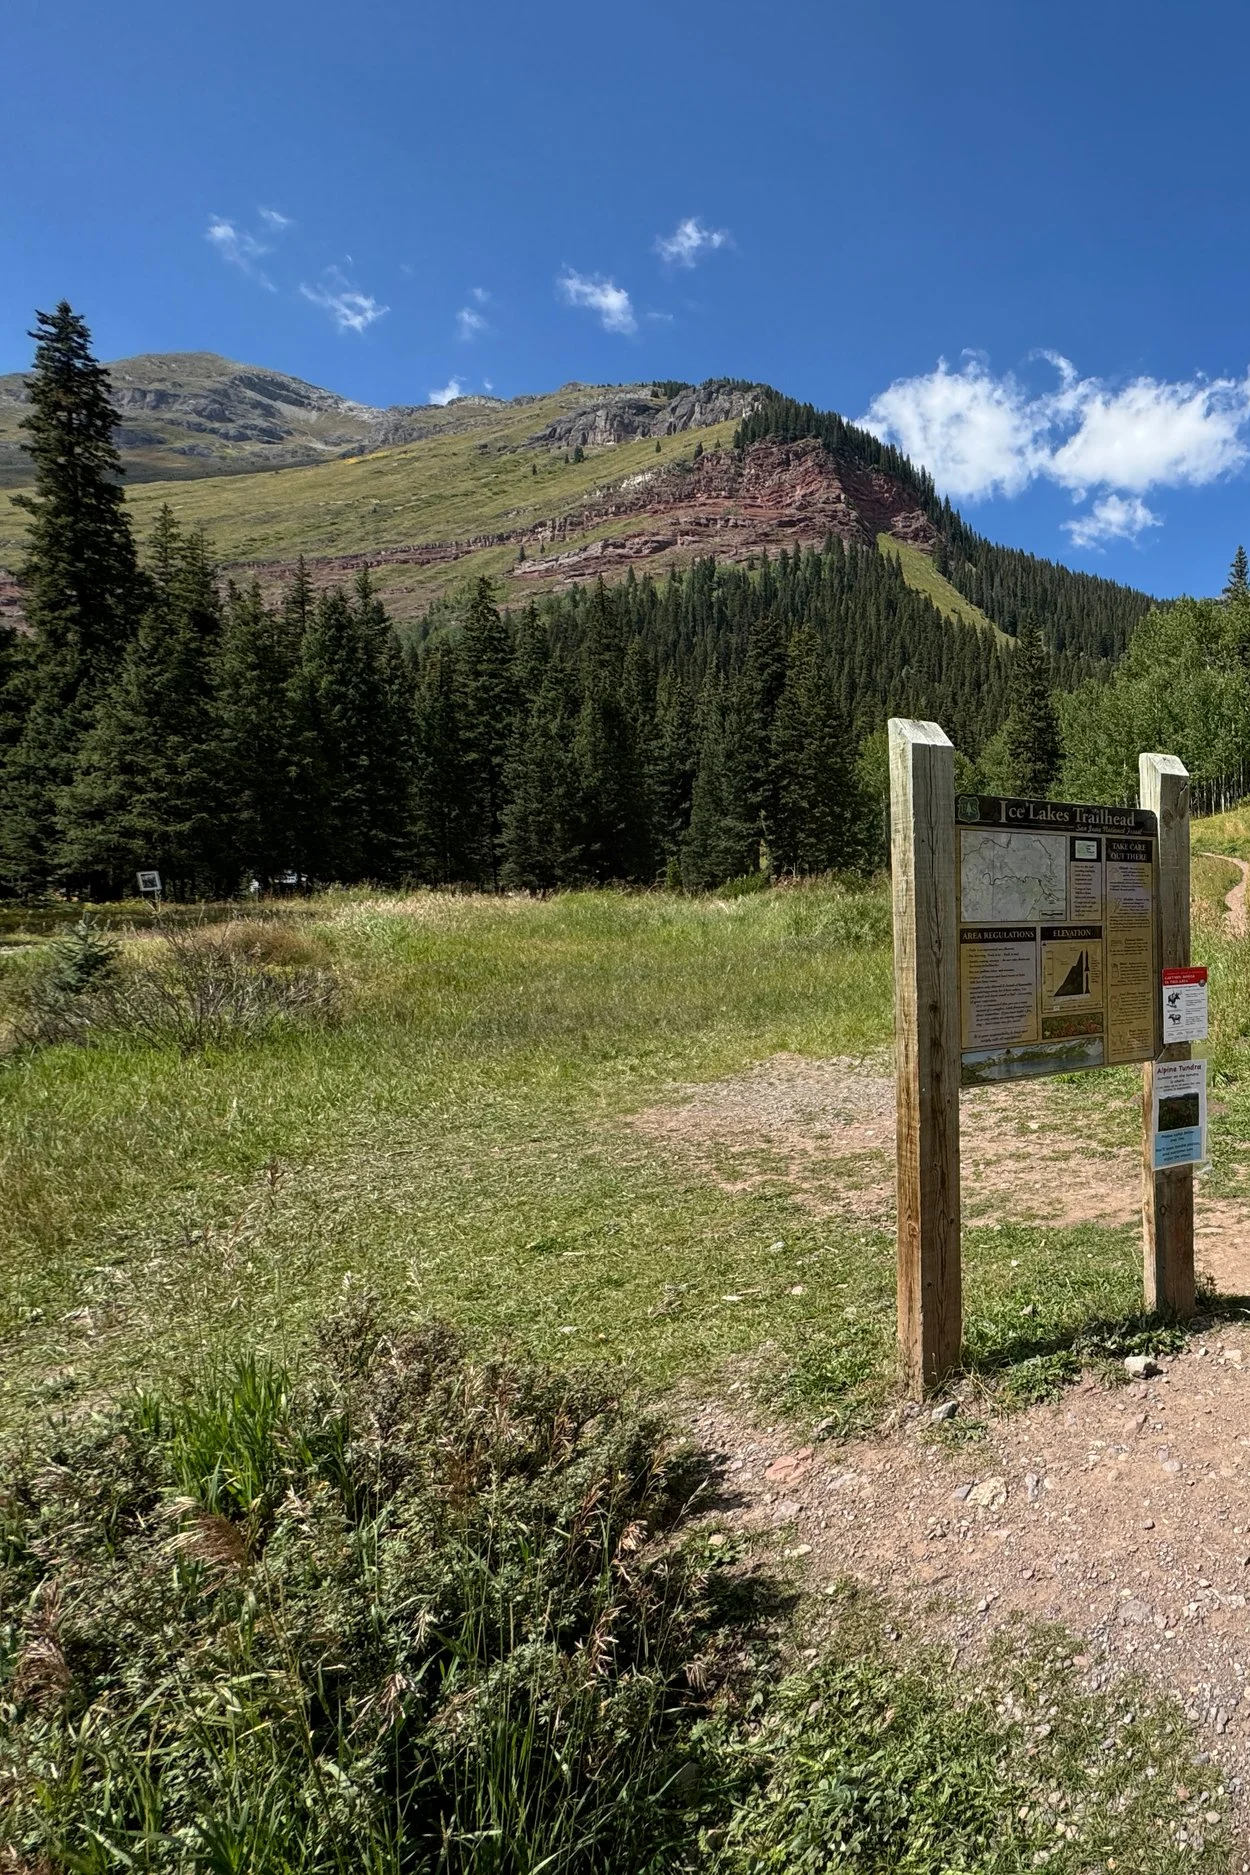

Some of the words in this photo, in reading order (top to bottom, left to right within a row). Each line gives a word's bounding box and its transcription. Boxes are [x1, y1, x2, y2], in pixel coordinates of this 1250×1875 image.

[999, 800, 1024, 823] Ice
[1028, 803, 1070, 823] Lakes
[1073, 807, 1135, 826] Trailhead
[1129, 843, 1146, 851] CARE
[962, 931, 982, 940] AREA
[984, 930, 1035, 939] REGULATIONS
[1053, 928, 1092, 937] ELEVATION
[1156, 1065, 1177, 1075] Alpine
[1178, 1063, 1202, 1072] Tundra
